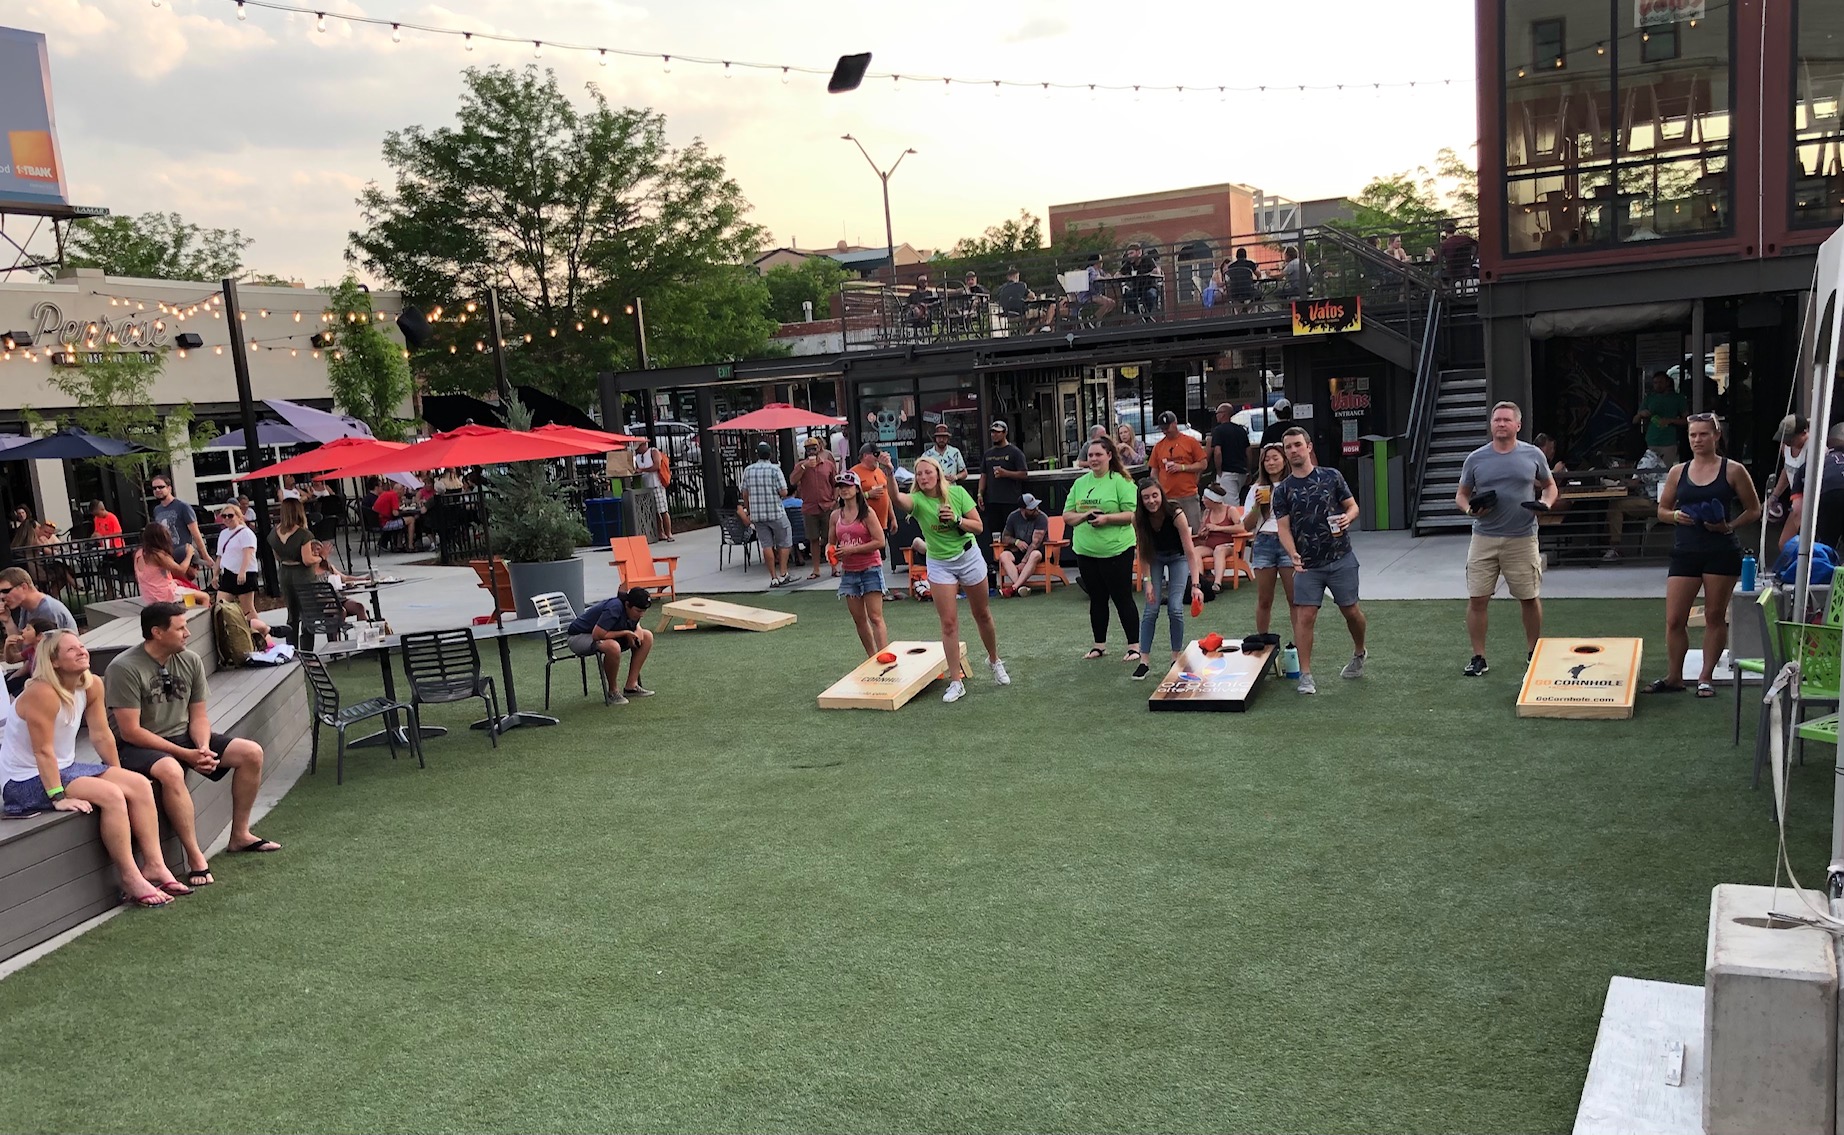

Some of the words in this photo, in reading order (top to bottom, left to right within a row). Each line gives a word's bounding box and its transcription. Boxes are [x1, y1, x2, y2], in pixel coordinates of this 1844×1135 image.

[76, 206, 105, 215] LAMAR
[1308, 300, 1345, 321] Vatos
[31, 301, 169, 347] Penrose
[1330, 389, 1369, 412] Vatos
[1334, 409, 1365, 418] ENTRANCE
[1343, 445, 1360, 453] NOSH
[1161, 681, 1249, 690] organic
[1554, 679, 1624, 687] CORNHOLE
